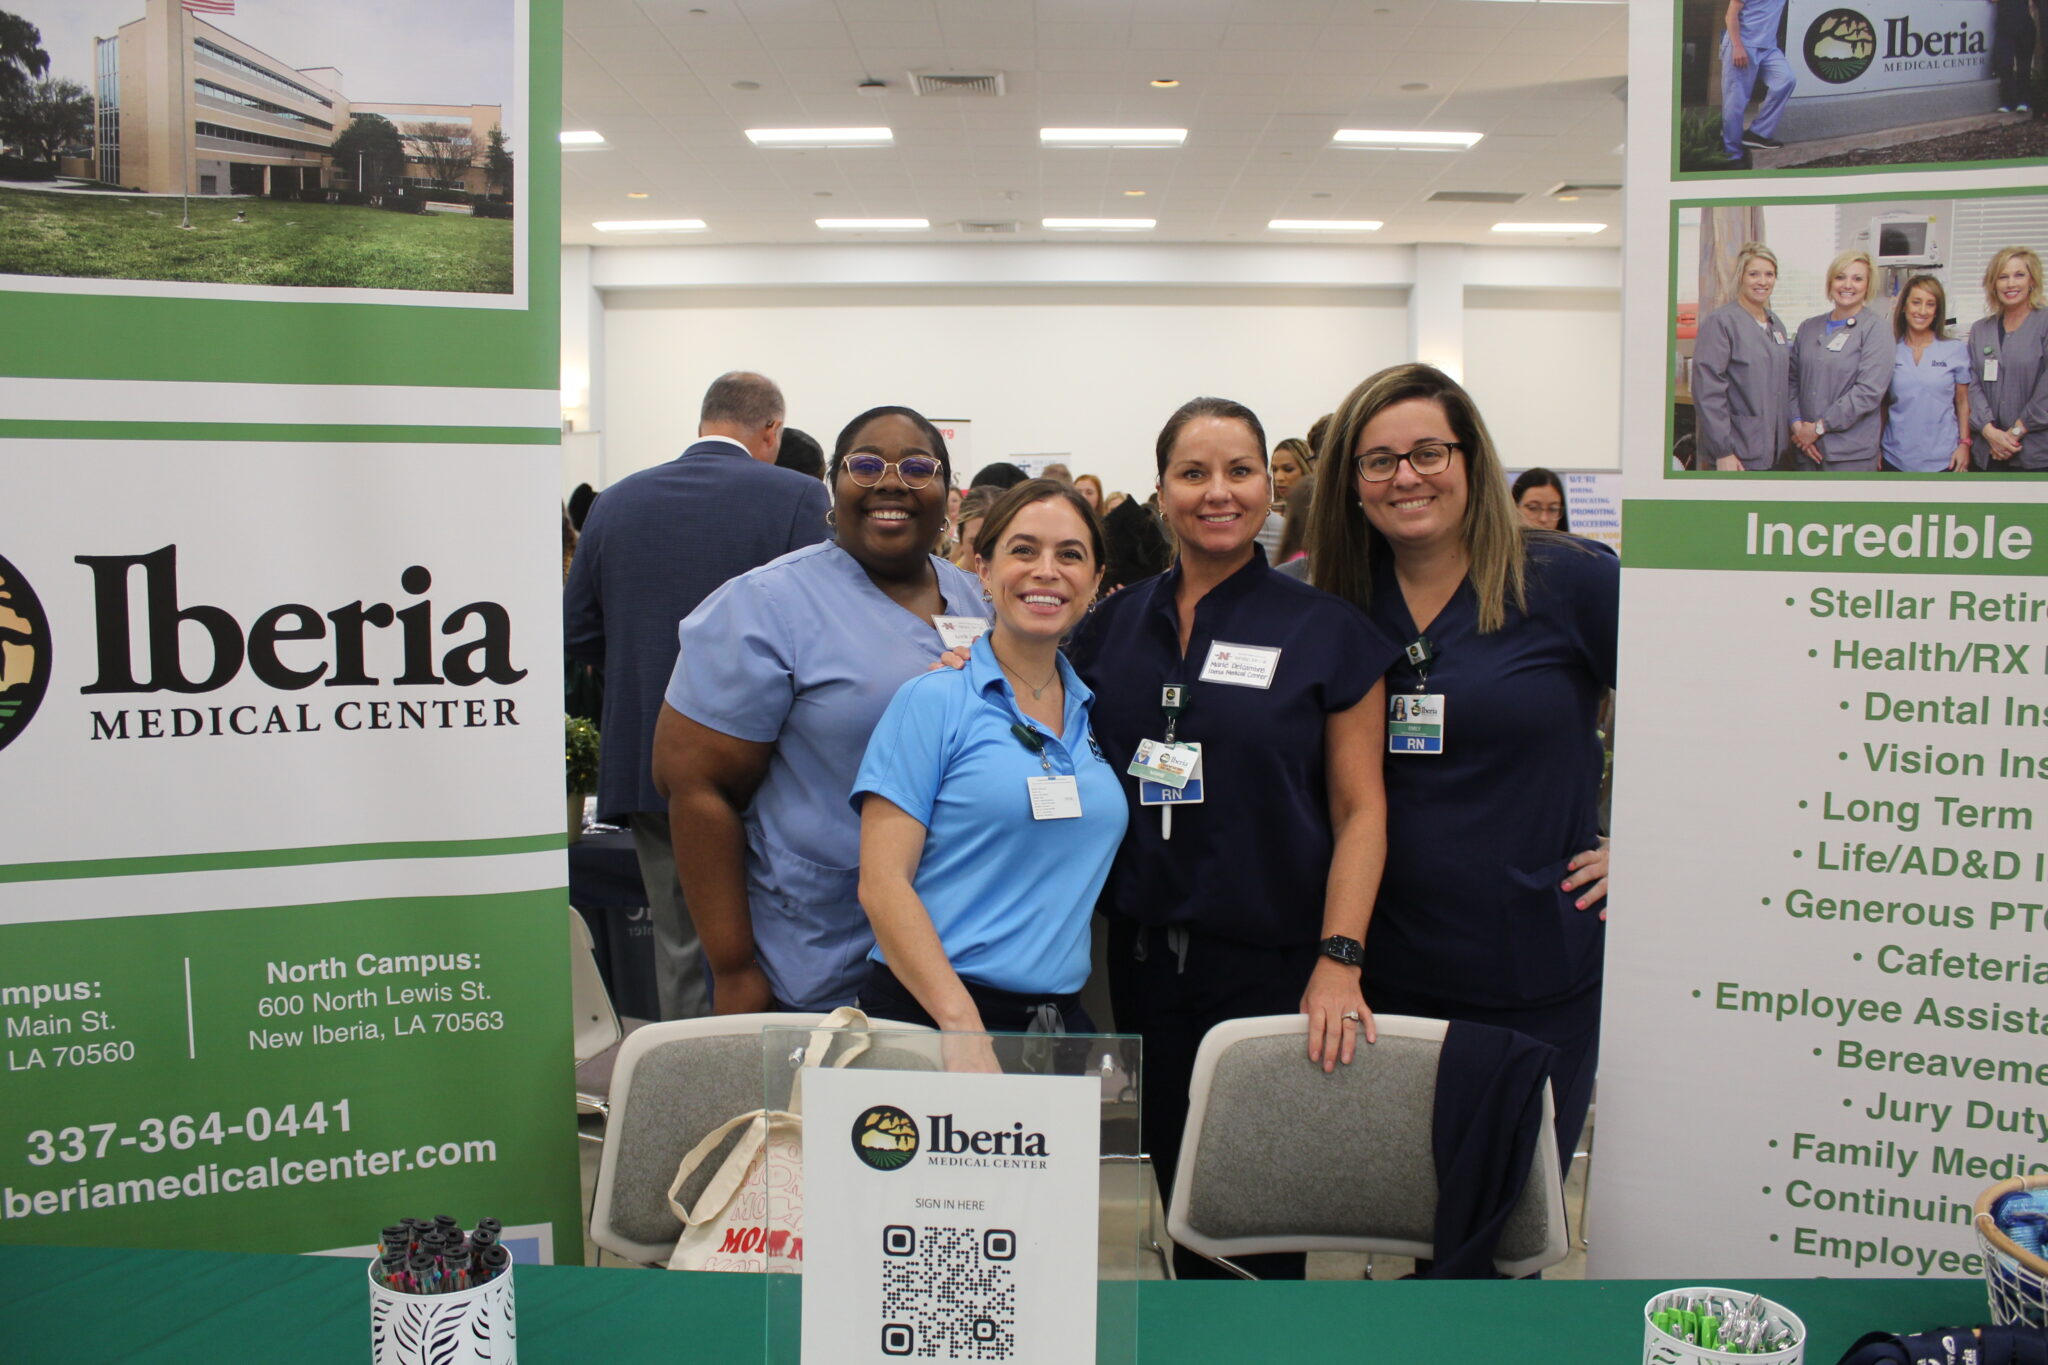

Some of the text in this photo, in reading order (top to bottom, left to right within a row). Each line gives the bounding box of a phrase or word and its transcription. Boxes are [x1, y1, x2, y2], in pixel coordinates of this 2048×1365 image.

[1882, 15, 1988, 59] Iberia
[1884, 57, 1985, 72] MEDICAL CENTER
[1747, 513, 2031, 559] Incredible
[75, 544, 528, 695] Iberia
[1810, 588, 2048, 622] Stellar Retir
[1834, 640, 2029, 674] Health/RX
[91, 699, 519, 740] MEDICAL CENTER
[1865, 692, 1989, 724] Dental
[1407, 738, 1425, 750] RN
[1864, 743, 1984, 776] Vision
[1162, 789, 1183, 801] RN
[1824, 792, 2032, 832] Long Term
[1818, 842, 2020, 880] Life/AD&D
[1786, 889, 2048, 932] Generous PT
[268, 953, 480, 984] North Campus:
[1878, 945, 2048, 984] Cafeteria
[2, 982, 100, 1008] mpus:
[259, 981, 490, 1017] 600 North Lewis St.
[1717, 982, 1901, 1026] Employee
[7, 1011, 115, 1037] Main St.
[250, 1011, 503, 1050] New Iberia, LA 70563
[10, 1041, 134, 1070] LA 70560
[1866, 1092, 1952, 1132] Jury
[27, 1099, 351, 1166] 337-364-0441
[927, 1114, 1049, 1157] Iberia
[928, 1156, 1047, 1169] MEDICAL CENTER
[1793, 1133, 1918, 1177] Family
[0, 1137, 497, 1220] beriamedicalcenter.com
[915, 1198, 985, 1211] SIGN IN HERE
[1793, 1227, 1984, 1276] Employee
